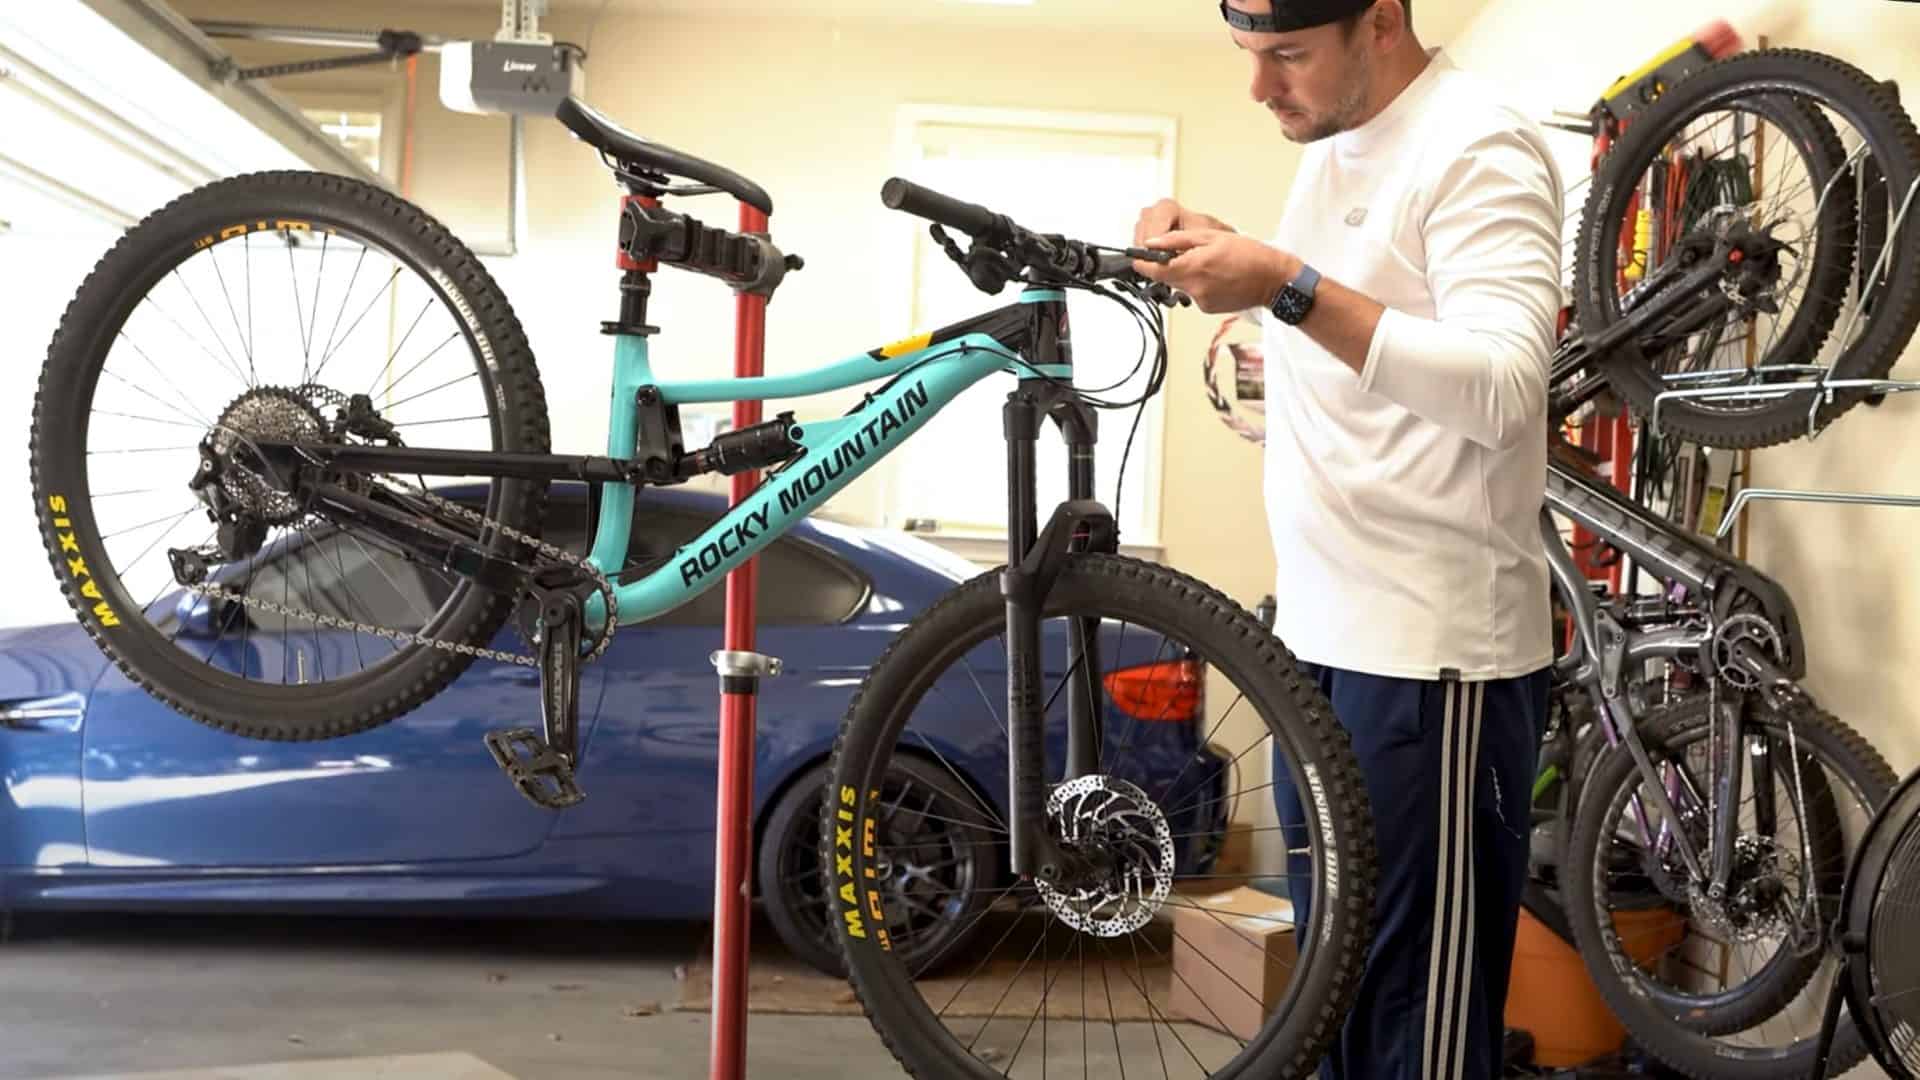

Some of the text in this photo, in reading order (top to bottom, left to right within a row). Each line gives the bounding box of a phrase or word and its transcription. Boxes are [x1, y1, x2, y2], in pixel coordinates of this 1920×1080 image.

[679, 380, 929, 588] ROCKY MOUNTAIN
[49, 495, 121, 627] MAXXIS
[836, 785, 867, 938] MAXXIS
[1303, 762, 1336, 847] MINION
